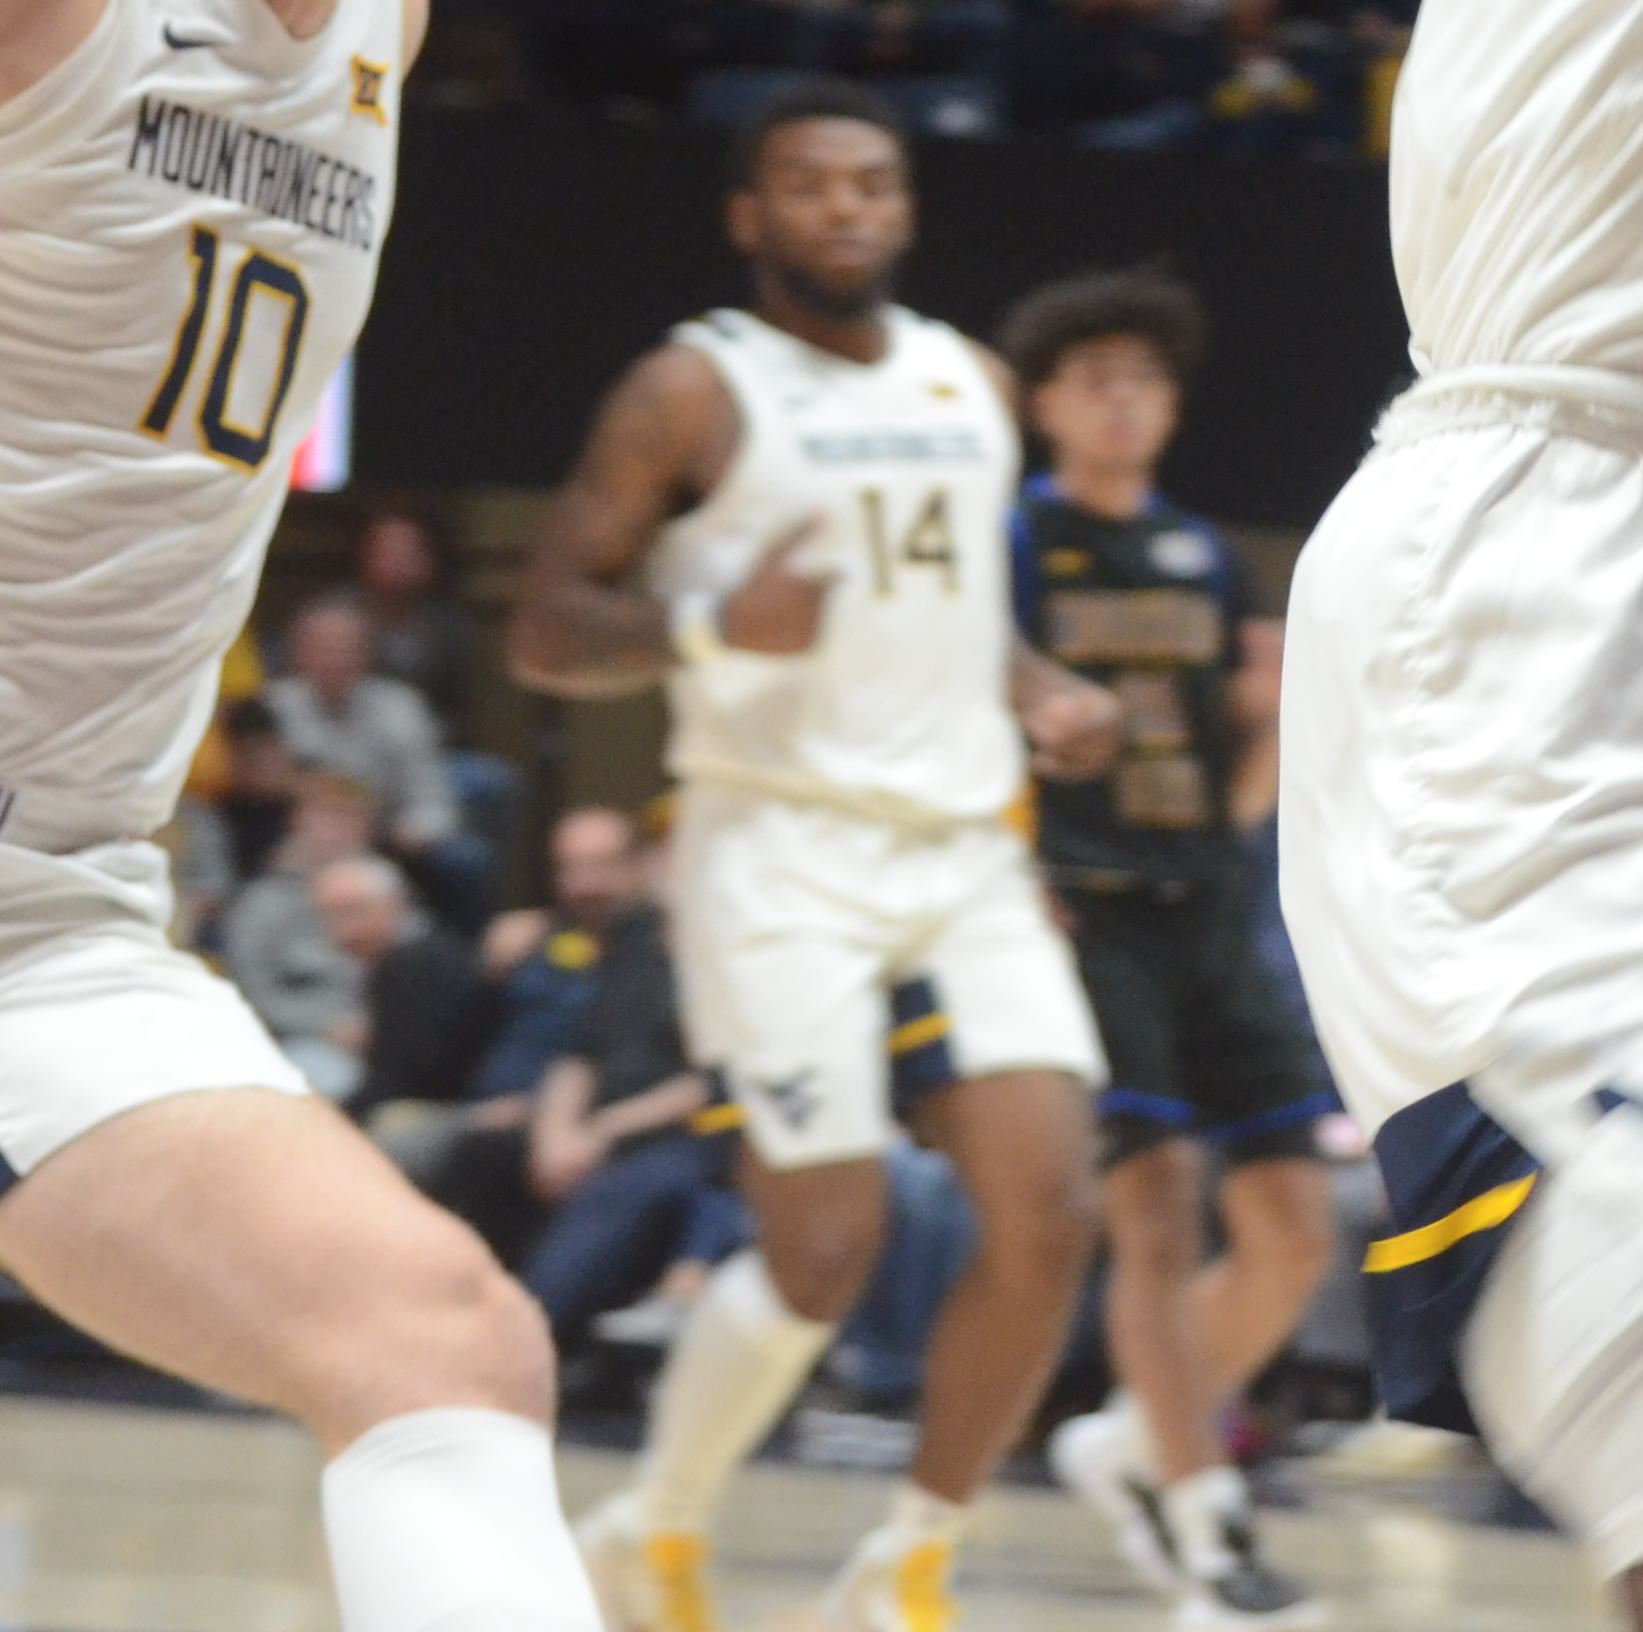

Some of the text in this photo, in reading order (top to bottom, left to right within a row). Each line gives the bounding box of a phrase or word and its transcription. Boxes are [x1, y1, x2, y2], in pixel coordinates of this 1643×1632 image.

[128, 93, 376, 252] MOUNTAINEERS
[137, 222, 312, 475] 10
[858, 483, 961, 600] 14
